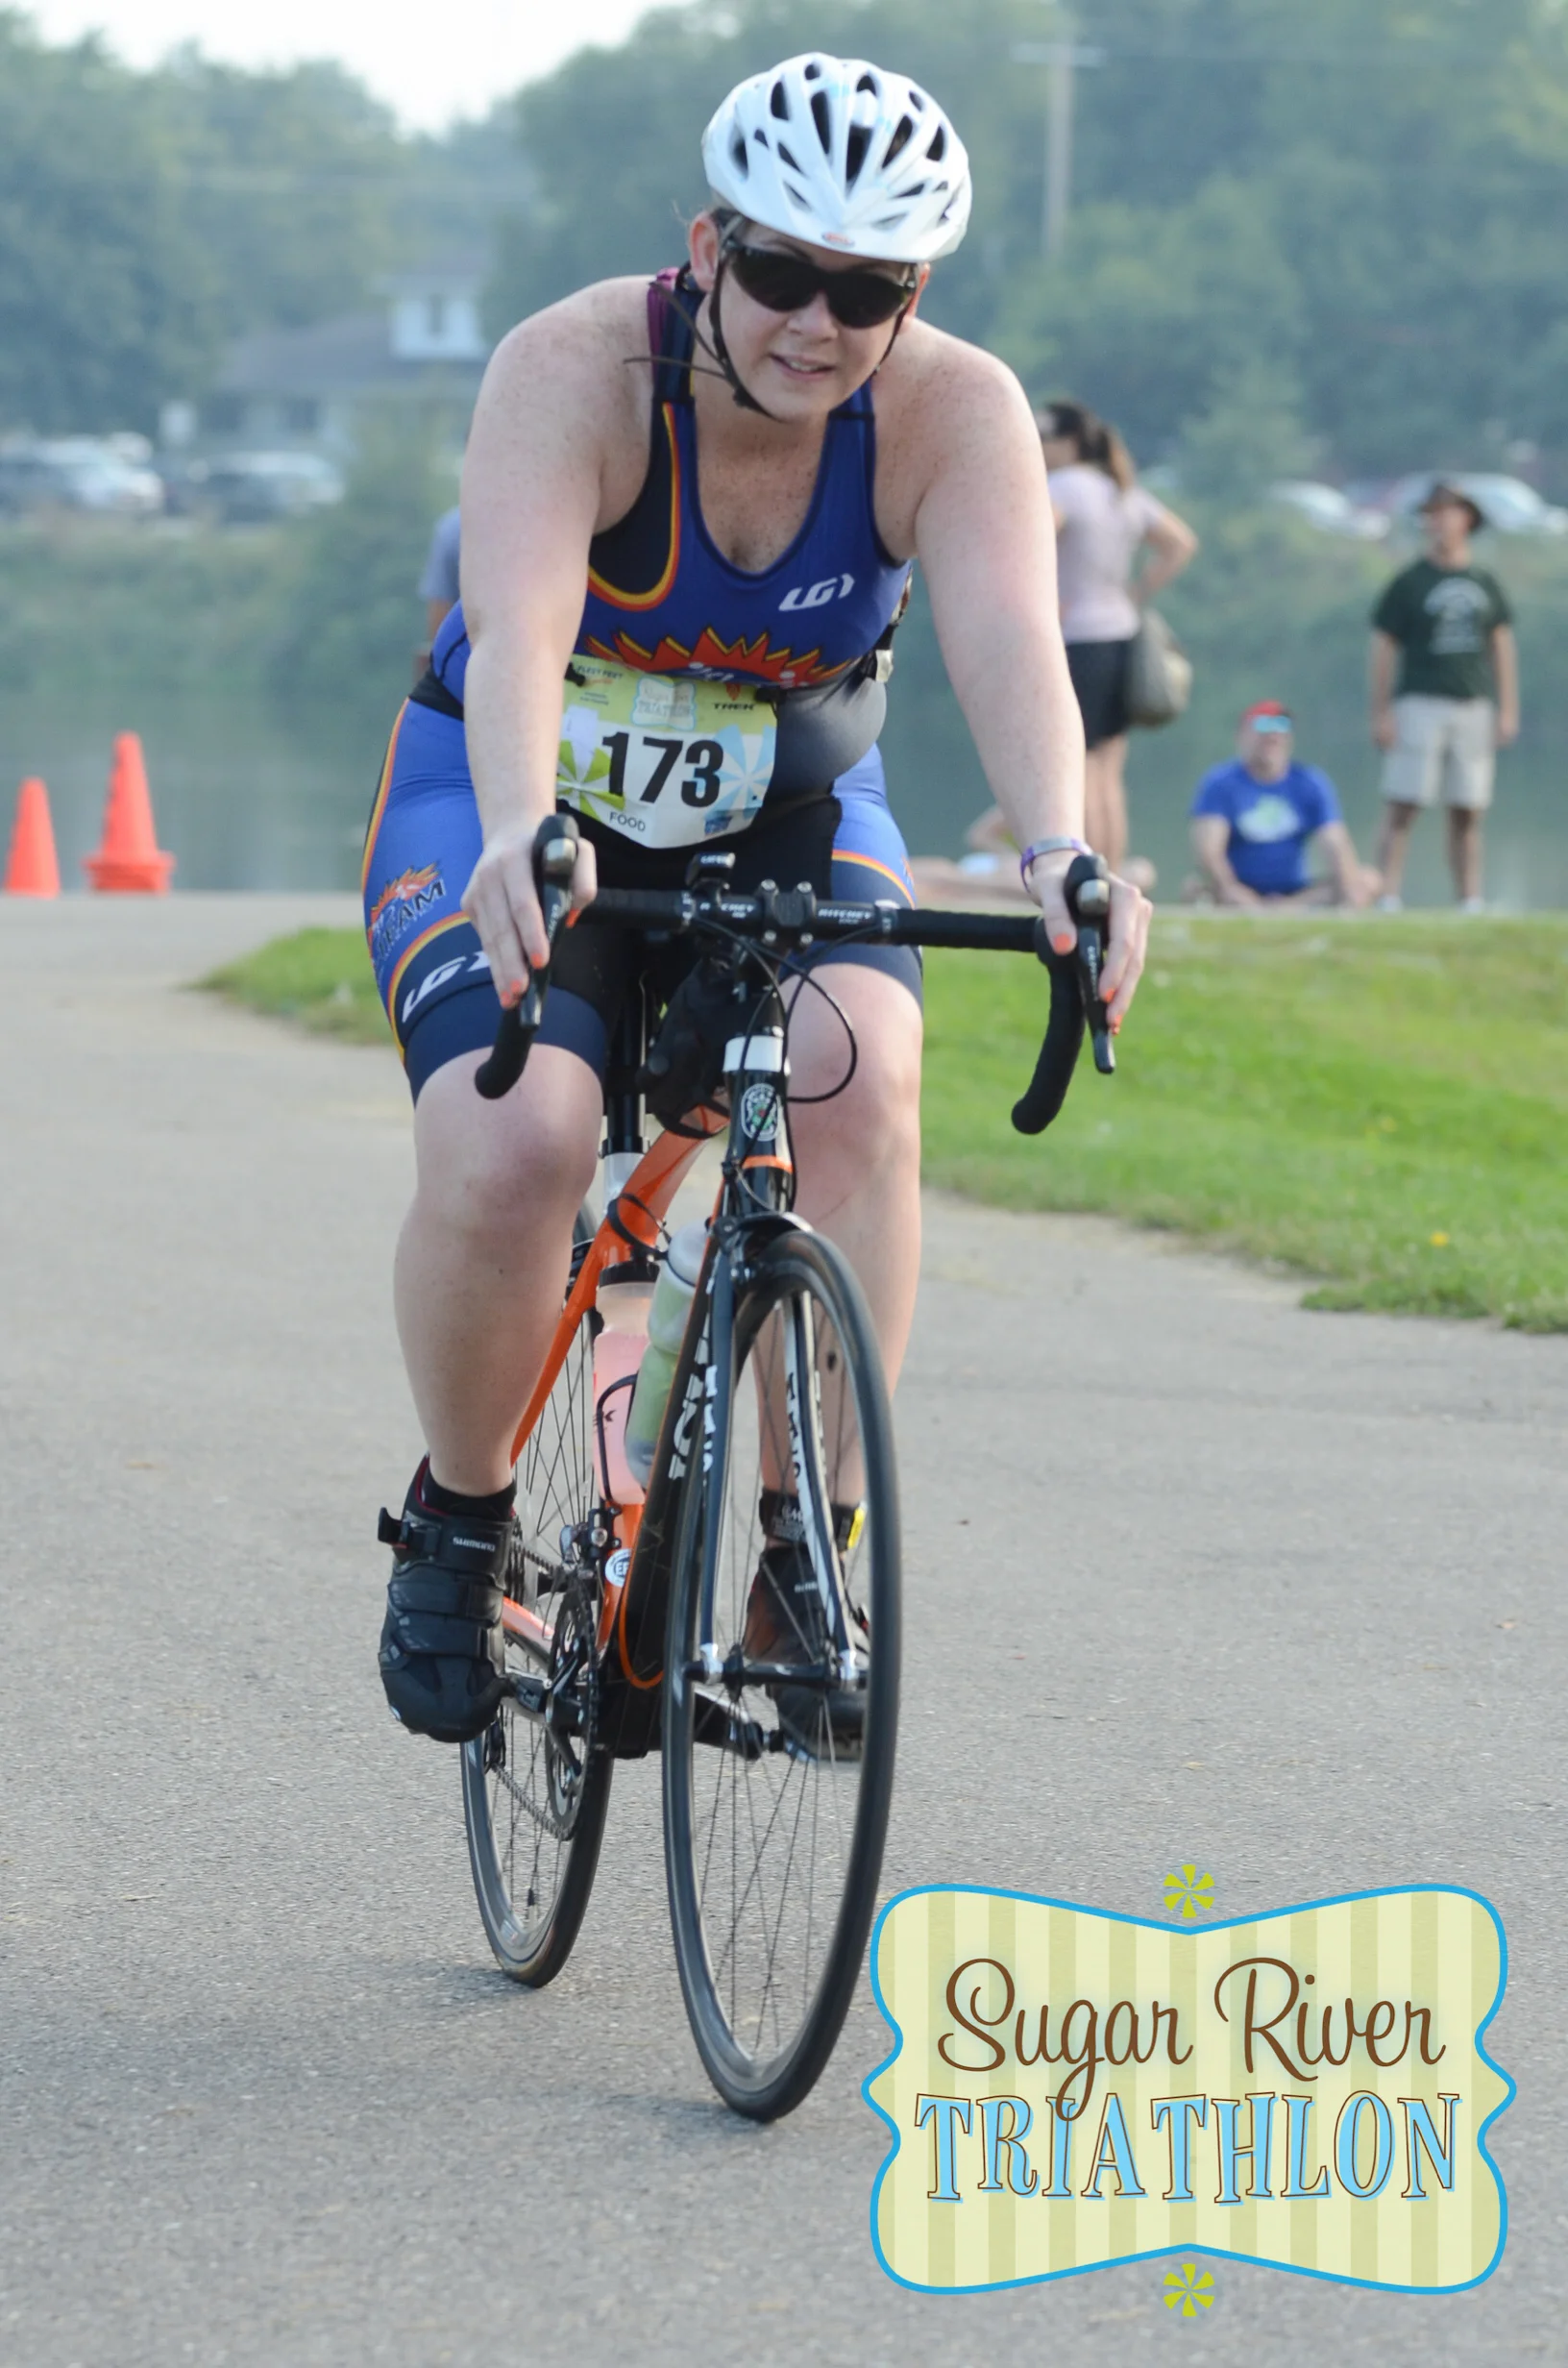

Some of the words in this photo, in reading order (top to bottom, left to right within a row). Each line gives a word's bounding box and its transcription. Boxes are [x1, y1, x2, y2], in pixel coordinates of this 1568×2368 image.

[713, 703, 754, 711] TREK
[602, 731, 723, 808] 173
[608, 811, 647, 832] FOOD
